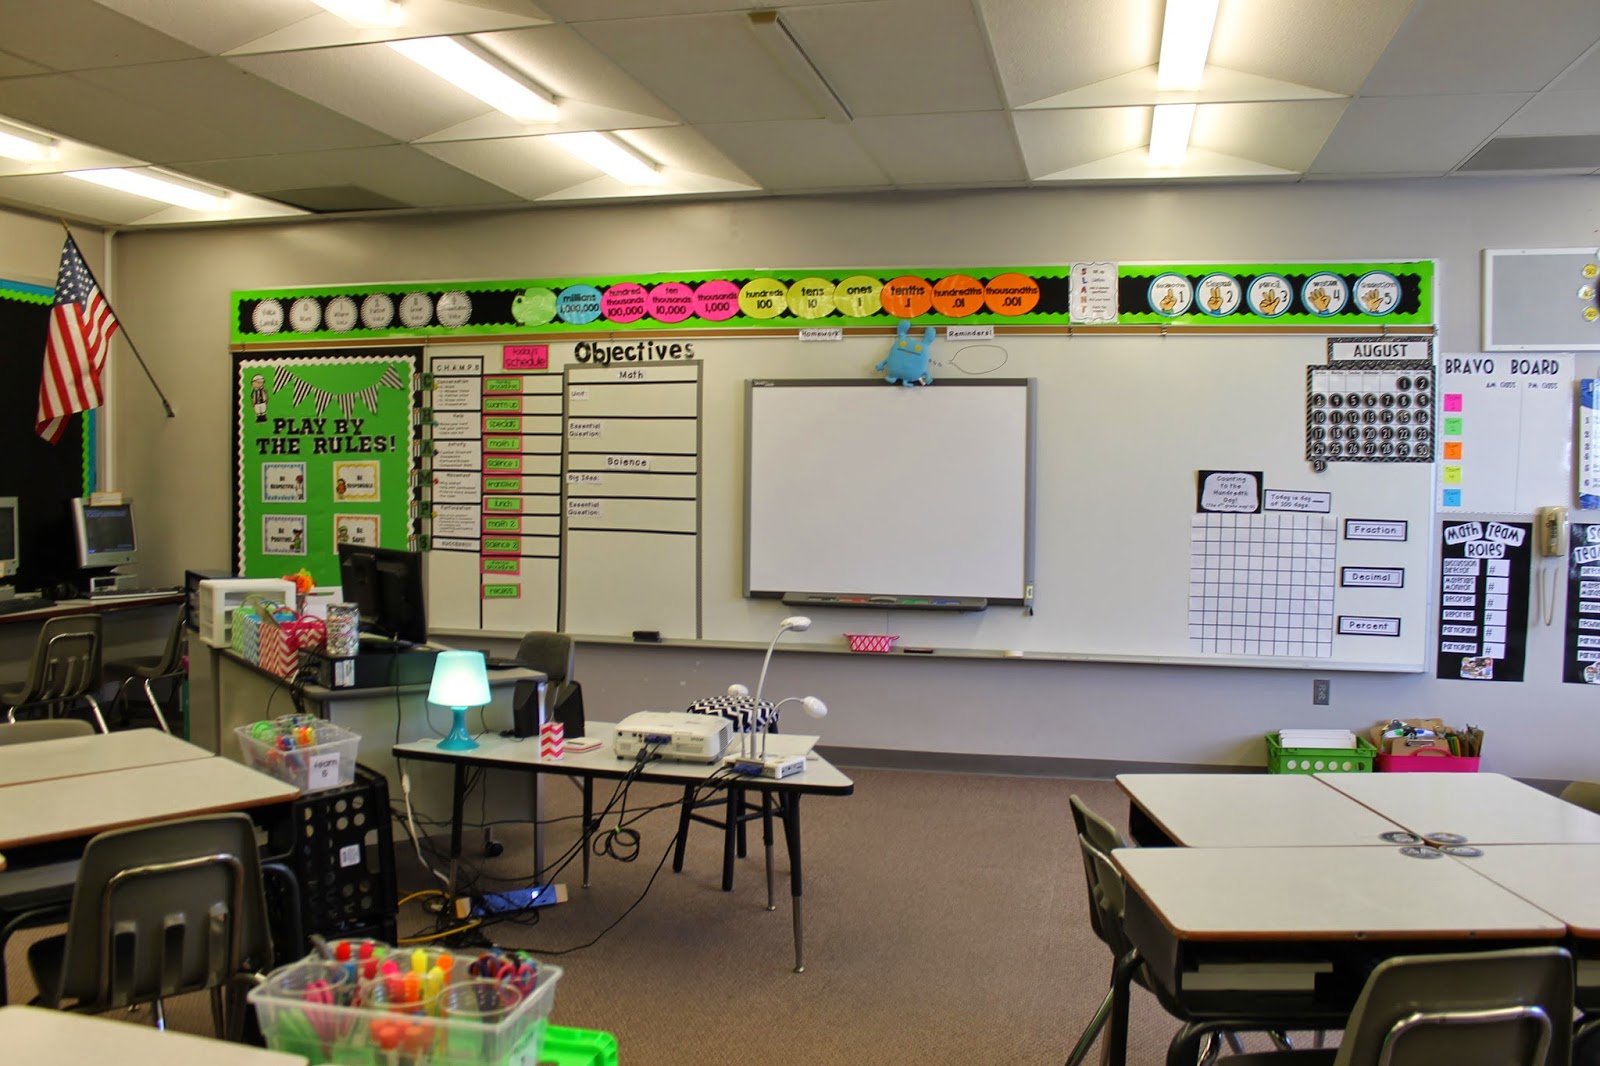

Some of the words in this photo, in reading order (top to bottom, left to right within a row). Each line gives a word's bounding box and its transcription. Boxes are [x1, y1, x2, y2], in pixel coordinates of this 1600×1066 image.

[609, 287, 641, 296] hundred
[746, 289, 783, 298] hundreds
[801, 287, 824, 297] tens
[847, 285, 873, 295] ones
[891, 285, 925, 296] tenths
[934, 288, 983, 297] hundredths
[986, 286, 1038, 295] thousandths
[1333, 289, 1340, 301] 4
[563, 294, 597, 302] millions
[606, 296, 645, 305] thousands
[652, 295, 692, 304] thousands
[698, 292, 738, 301] thousands
[1179, 290, 1184, 303] 1
[1226, 290, 1234, 303] 2
[1280, 290, 1287, 303] 3
[1384, 292, 1392, 304] 5
[705, 302, 730, 312] 1,000
[757, 299, 773, 309] 100
[808, 299, 817, 309] 10
[904, 298, 911, 308] .1
[952, 298, 965, 308] .01
[1002, 297, 1022, 307] .001
[560, 303, 599, 314] 1,000,000
[608, 306, 644, 317] 100,000
[656, 305, 686, 315] 10,000
[801, 329, 841, 337] Homework
[948, 329, 992, 337] Reminders!
[574, 341, 695, 366] Objectives
[1353, 344, 1408, 357] AUGUST
[505, 357, 546, 367] schedule
[1445, 358, 1495, 375] BRAVO
[1510, 359, 1559, 375] BOARD
[619, 371, 644, 380] Math
[273, 418, 327, 435] PLAY
[334, 419, 364, 436] BY
[256, 438, 301, 455] THE
[313, 435, 396, 455] RULES!
[607, 457, 647, 467] Science
[568, 475, 580, 483] Big
[1216, 475, 1247, 483] Counting
[1271, 494, 1291, 502] Today
[1300, 495, 1312, 503] day
[1354, 525, 1397, 535] Fraction
[1447, 523, 1479, 540] Math
[1352, 573, 1392, 582] Decimal
[1349, 621, 1389, 630] Percent
